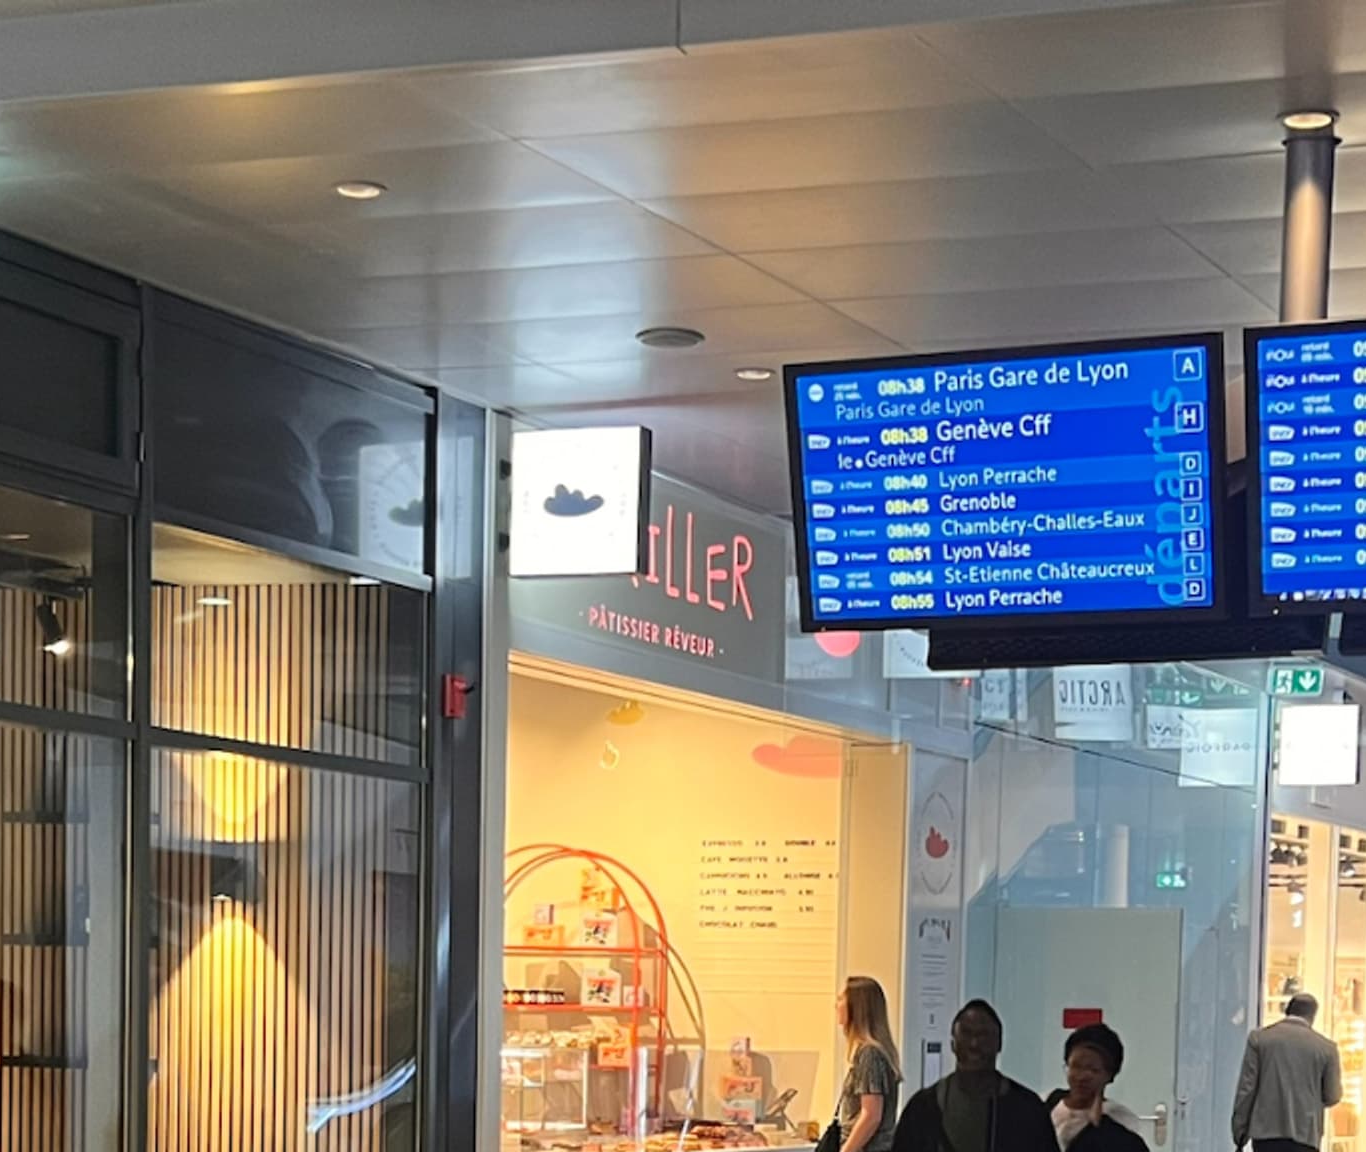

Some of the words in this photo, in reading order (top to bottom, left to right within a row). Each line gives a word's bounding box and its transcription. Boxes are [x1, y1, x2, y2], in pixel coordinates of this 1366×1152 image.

[1181, 357, 1195, 373] A
[877, 377, 926, 396] 08h38
[935, 368, 984, 392] Paris
[989, 366, 1038, 388] Gare
[1044, 362, 1070, 384] de
[1077, 360, 1129, 387] Lyon
[836, 403, 874, 420] Paris
[878, 400, 916, 418] Gare
[920, 398, 941, 415] de
[945, 397, 984, 417] Lyon
[1183, 408, 1196, 425] H
[880, 425, 929, 446] 08h38
[936, 418, 1014, 441] Genève
[1019, 413, 1052, 436] Cff
[865, 448, 927, 468] Genève
[930, 445, 956, 463] Cff
[883, 474, 928, 491] 08h40
[939, 471, 978, 491] Lyon
[984, 466, 1057, 485] Perrache
[885, 497, 930, 515] 08h45
[940, 492, 1017, 512] Grenoble
[887, 522, 930, 539] 08h50
[941, 510, 1145, 537] Chambéry-Challes-Eaux
[1188, 533, 1198, 546] E
[645, 504, 755, 621] ILLER
[888, 545, 931, 563] 08h51
[942, 543, 982, 564] Lyon
[986, 540, 1031, 559] Vaise
[889, 570, 933, 587] 08h54
[944, 567, 1033, 584] St-Etienne
[1037, 561, 1155, 580] Châteaucreux
[891, 593, 934, 610] 08h55
[945, 591, 985, 612] Lyon
[989, 588, 1063, 606] Perrache
[1189, 583, 1200, 595] D
[588, 604, 660, 644] PÂTISSIER
[664, 624, 715, 658] RÊVEUR
